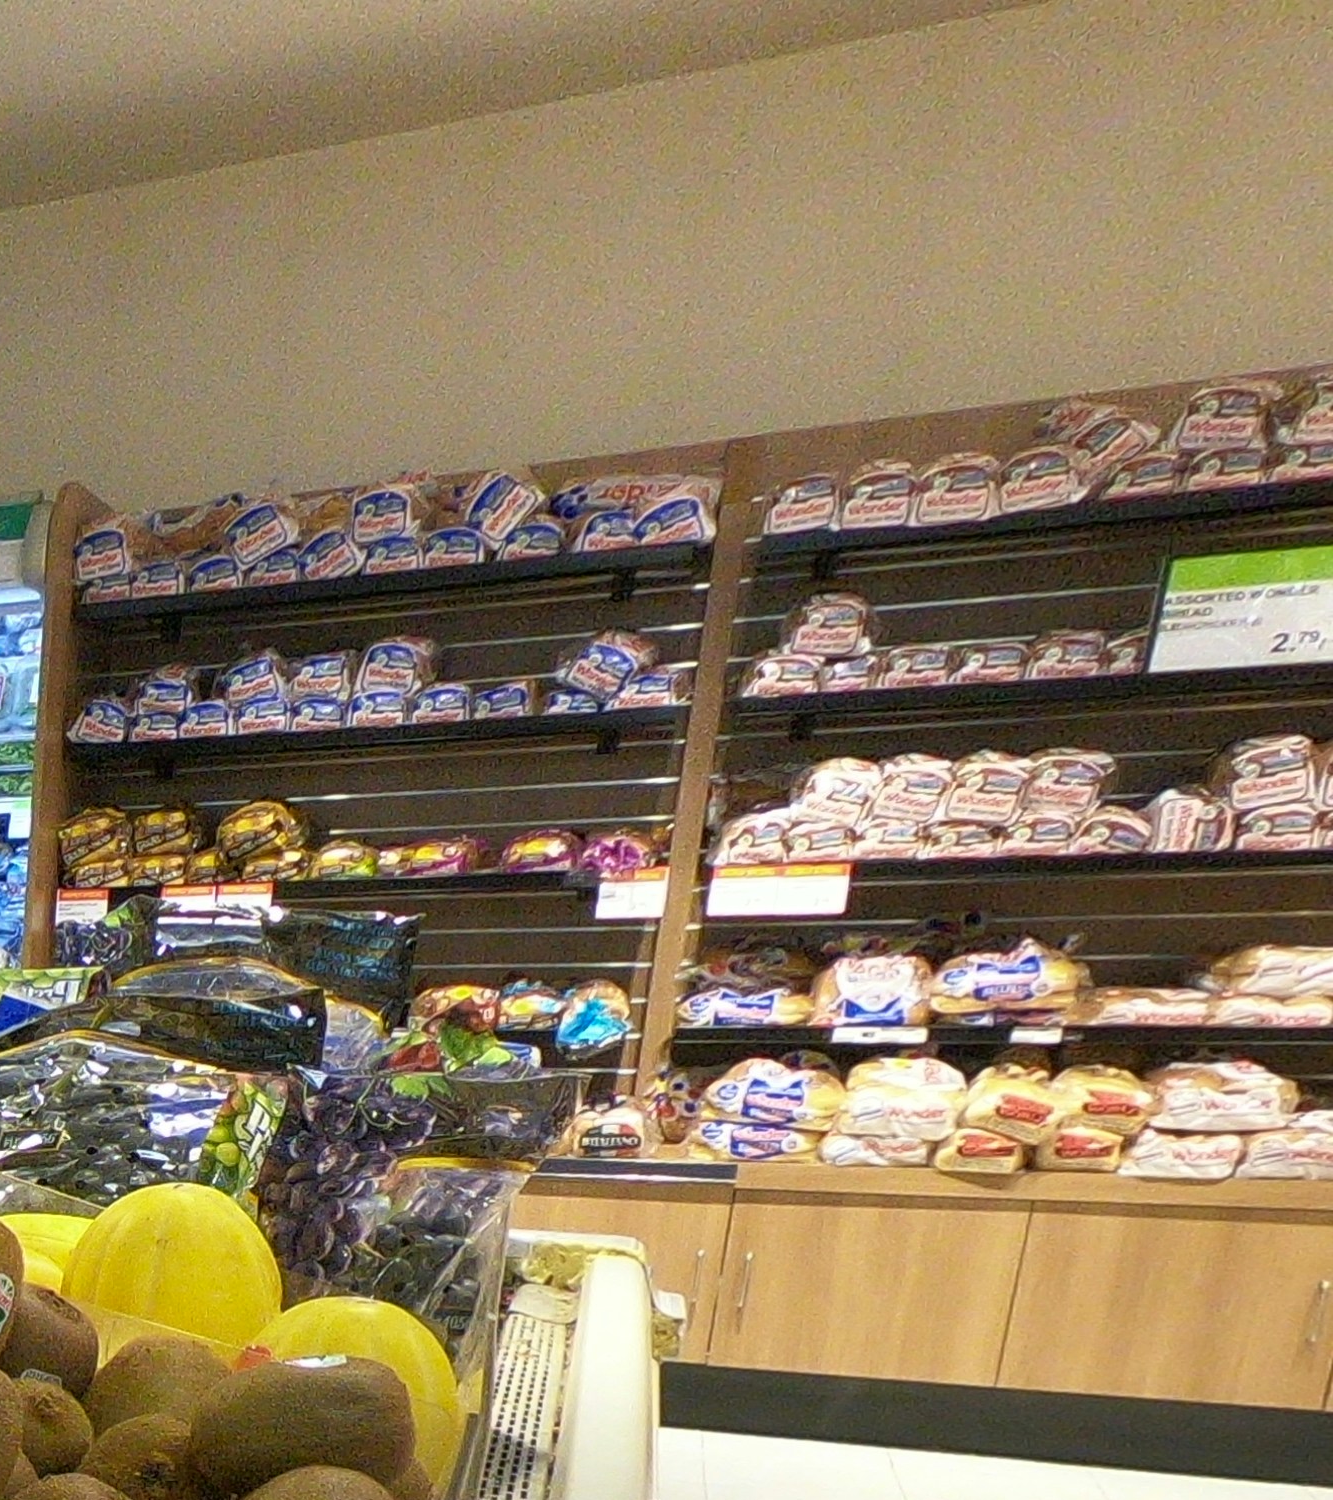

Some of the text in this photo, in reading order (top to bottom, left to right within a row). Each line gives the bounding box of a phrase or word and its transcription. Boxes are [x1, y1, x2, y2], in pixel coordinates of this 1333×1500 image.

[774, 502, 829, 521] Wonder
[847, 500, 905, 516] Wonder
[1165, 591, 1245, 605] ASSORTED
[183, 725, 222, 736] Wonder
